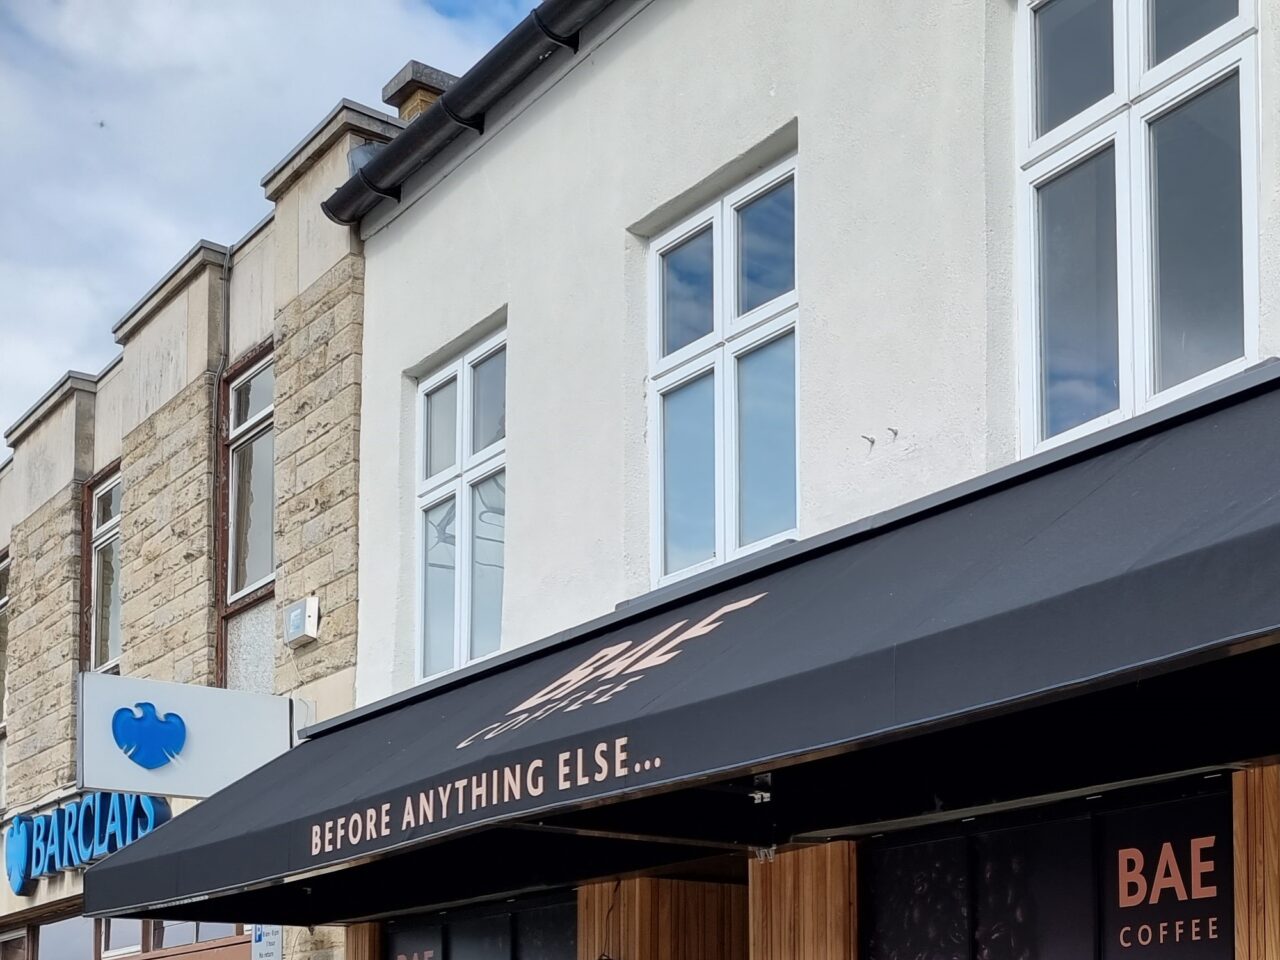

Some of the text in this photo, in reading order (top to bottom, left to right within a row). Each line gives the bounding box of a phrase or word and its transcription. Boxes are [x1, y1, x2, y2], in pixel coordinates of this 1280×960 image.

[505, 592, 768, 715] BAE
[456, 675, 646, 750] COFFEE
[31, 791, 156, 880] BARCLAYS
[311, 736, 662, 856] BEFORE ANYTHING ELSE...
[1118, 835, 1217, 908] BAE
[1119, 917, 1218, 948] COFFEE
